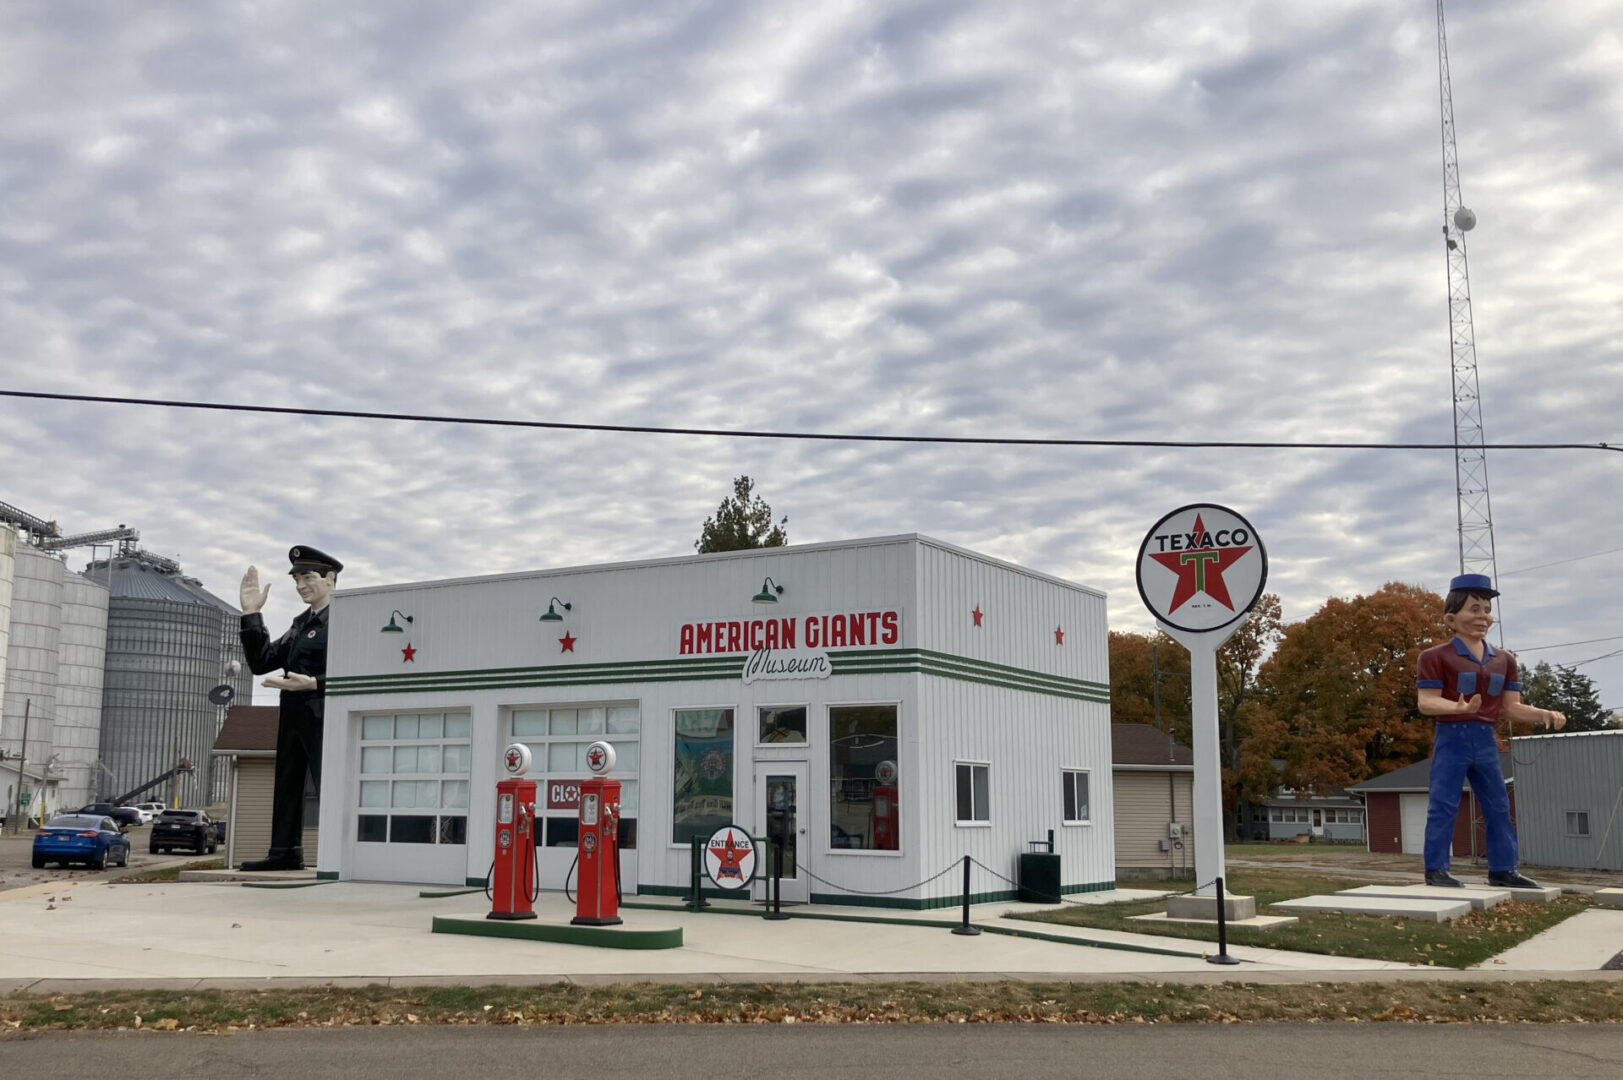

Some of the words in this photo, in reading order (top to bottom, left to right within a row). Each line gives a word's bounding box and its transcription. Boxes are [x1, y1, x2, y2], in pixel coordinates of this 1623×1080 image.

[1155, 528, 1249, 552] TEXACO
[679, 617, 796, 655] AMERICAN
[805, 611, 898, 648] GIANTS
[746, 646, 827, 678] Museum
[711, 839, 749, 849] ENTRANCE
